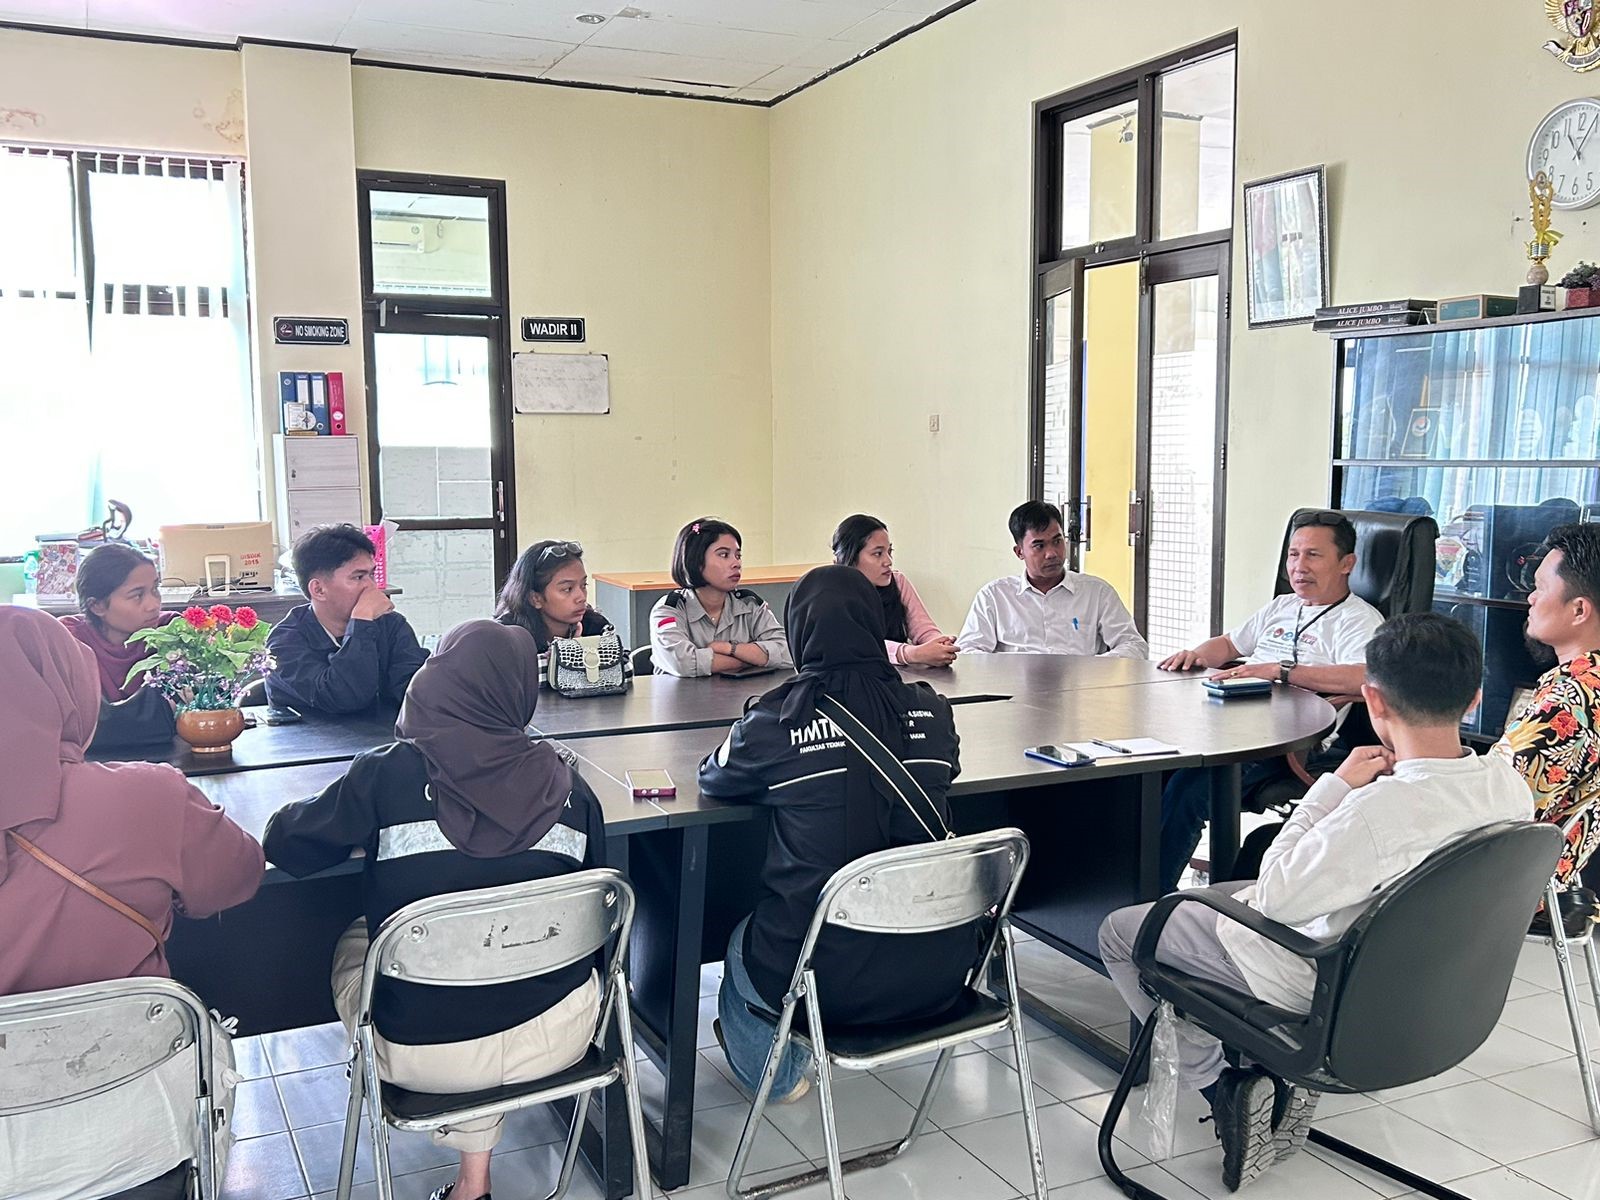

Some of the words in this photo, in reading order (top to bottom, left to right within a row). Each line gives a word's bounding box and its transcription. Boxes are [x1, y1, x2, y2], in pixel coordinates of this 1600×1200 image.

[1564, 118, 1571, 137] 11
[1578, 112, 1587, 131] 12
[1551, 130, 1560, 149] 10
[1543, 148, 1549, 166] 9
[1548, 165, 1554, 183] 8
[1586, 172, 1593, 191] 5
[1558, 174, 1565, 193] 7
[1572, 177, 1578, 195] 6
[1359, 304, 1383, 314] JUMBO
[295, 325, 304, 336] NO
[304, 326, 330, 337] SMOKING
[329, 326, 345, 337] ZONE
[530, 323, 569, 335] WADIR
[570, 323, 578, 336] II
[1336, 319, 1357, 327] ALICE
[1357, 317, 1381, 327] JUMBO
